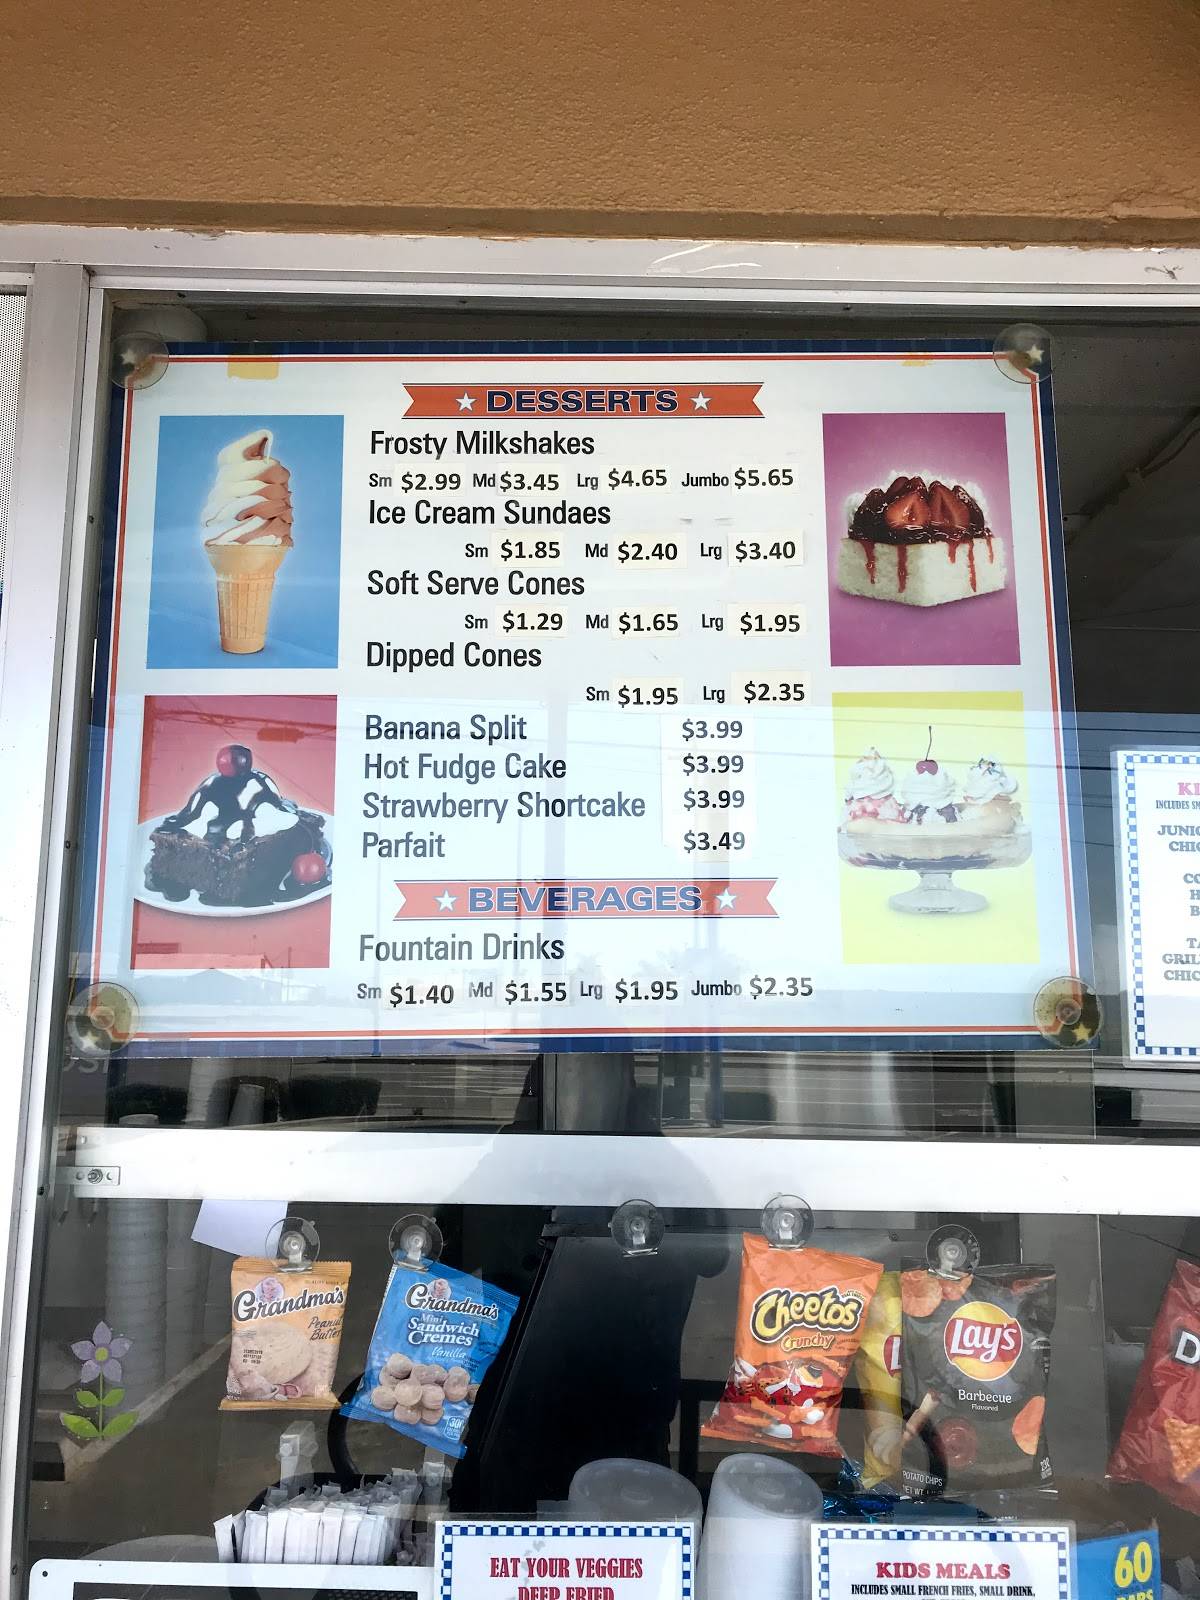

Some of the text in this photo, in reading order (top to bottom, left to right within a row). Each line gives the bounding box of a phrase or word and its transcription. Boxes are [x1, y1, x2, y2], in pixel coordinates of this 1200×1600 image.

[486, 390, 678, 413] DESSERTS
[370, 430, 595, 460] Frosty Milkshakes
[369, 467, 793, 492] Sm $2.99 Md $3.45 Lrg $4.65 Jumbo $5.65
[369, 499, 610, 524] Ice Cream Sundaes
[465, 540, 796, 562] Sm $1.85 Md $2.40 Lrg $3.40
[368, 570, 584, 595] Soft Serve Cones
[465, 612, 800, 635] Sm $1.29 Md $1.65 Lrg $1.95
[367, 642, 542, 672] Dipped Cones
[586, 682, 804, 708] Sm $1.95 Lrg $2.35
[365, 714, 742, 745] Banana Split $3.99
[364, 752, 743, 784] Hot Fudge Cake $3.99
[363, 788, 744, 822] Strawberry Shortcake $3.99
[1156, 800, 1190, 810] INCLUDES
[363, 831, 745, 858] Parfait $3.49
[468, 887, 701, 913] BEVERAGES
[360, 933, 565, 961] Fountain Drinks
[357, 977, 813, 1006] Sm $1.40 Md $1.55 Lrg $1.95 Jumbo $2.35
[232, 1286, 344, 1322] Grandma's
[405, 1283, 498, 1320] Grandma's
[752, 1287, 862, 1341] Cheetos
[408, 1317, 480, 1337] Sandwich
[422, 1313, 444, 1322] Mini
[408, 1331, 472, 1346] Cremes
[781, 1332, 834, 1352] Crunchy
[950, 1320, 1017, 1362] Lay's
[432, 1346, 466, 1358] Vanilla
[958, 1389, 1012, 1404] Barbecue
[972, 1404, 998, 1412] Flavored
[902, 1470, 942, 1486] POTATO CHIPS
[490, 1558, 643, 1578] EAT YOUR VEGGIES
[876, 1562, 1010, 1580] KIDS MEALS
[1114, 1542, 1152, 1588] 60
[851, 1584, 888, 1595] INCLUDES
[890, 1584, 916, 1595] SMALL
[918, 1585, 948, 1596] FRENCH
[952, 1586, 977, 1597] FRIES,
[979, 1586, 1003, 1596] SMALL
